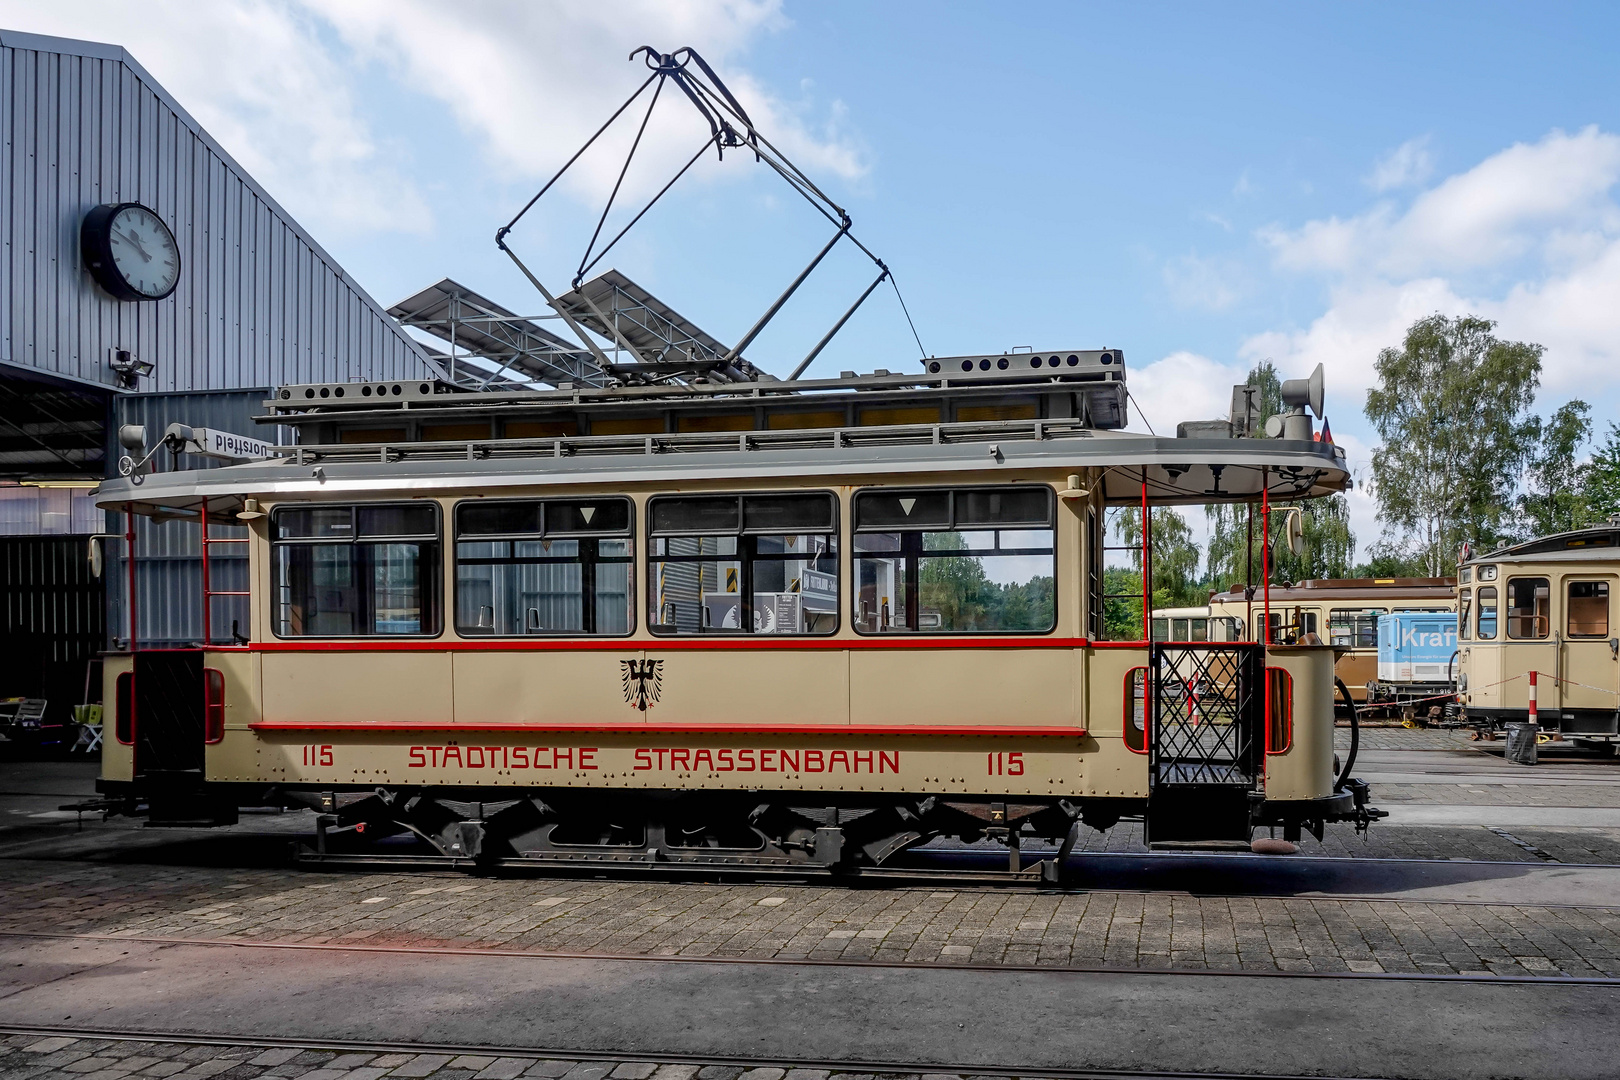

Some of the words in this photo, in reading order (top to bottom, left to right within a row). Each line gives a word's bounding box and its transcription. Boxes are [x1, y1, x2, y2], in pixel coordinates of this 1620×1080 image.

[216, 434, 267, 456] Dorstfeld
[1487, 567, 1493, 578] E
[1402, 627, 1457, 647] Kraf
[303, 745, 333, 767] 115
[408, 740, 598, 770] STÄDTISCHE
[633, 748, 899, 774] STRASSENBAHN
[987, 752, 1025, 776] 115
